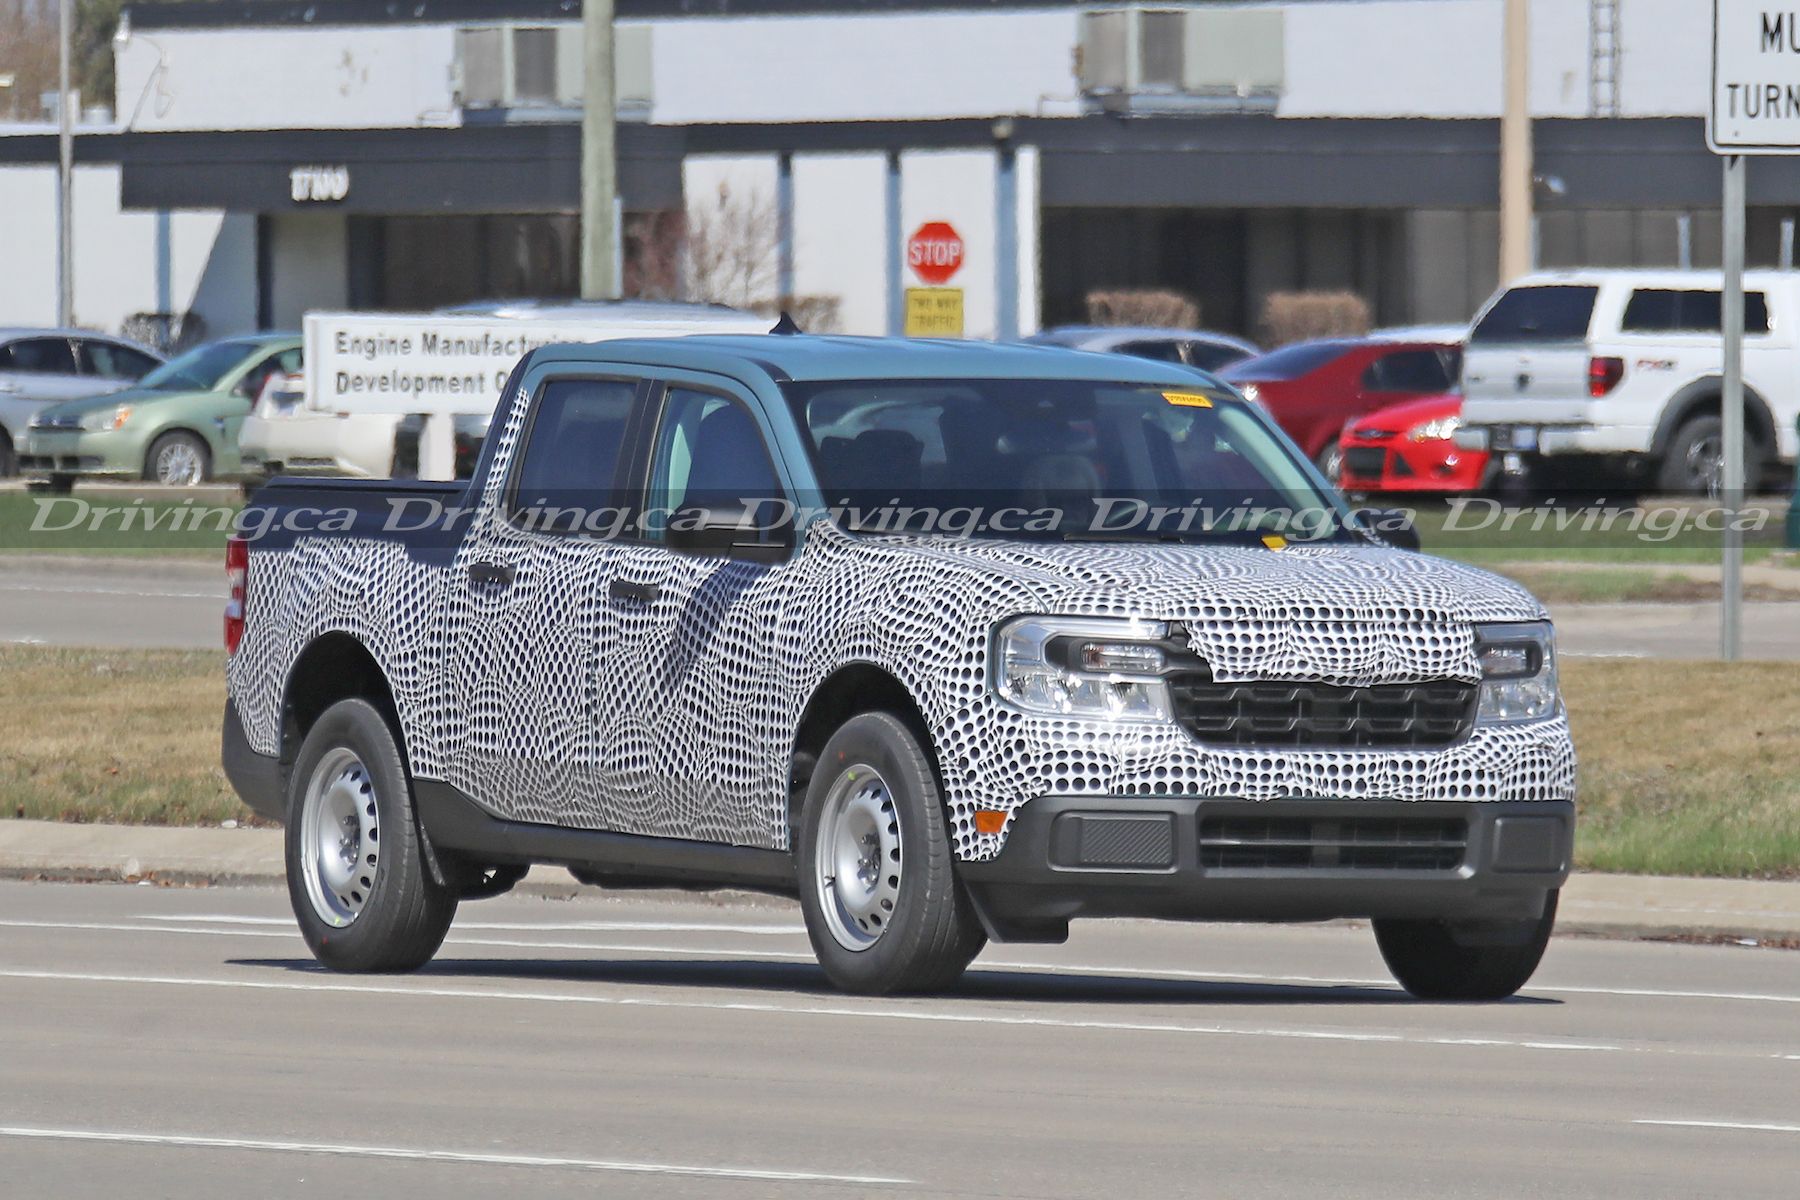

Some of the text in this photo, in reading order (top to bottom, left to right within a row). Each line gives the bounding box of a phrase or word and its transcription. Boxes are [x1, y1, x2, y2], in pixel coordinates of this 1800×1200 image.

[1726, 84, 1800, 119] TURN
[909, 240, 961, 267] STOP
[335, 331, 584, 361] Engine Manufact
[336, 370, 487, 398] Development
